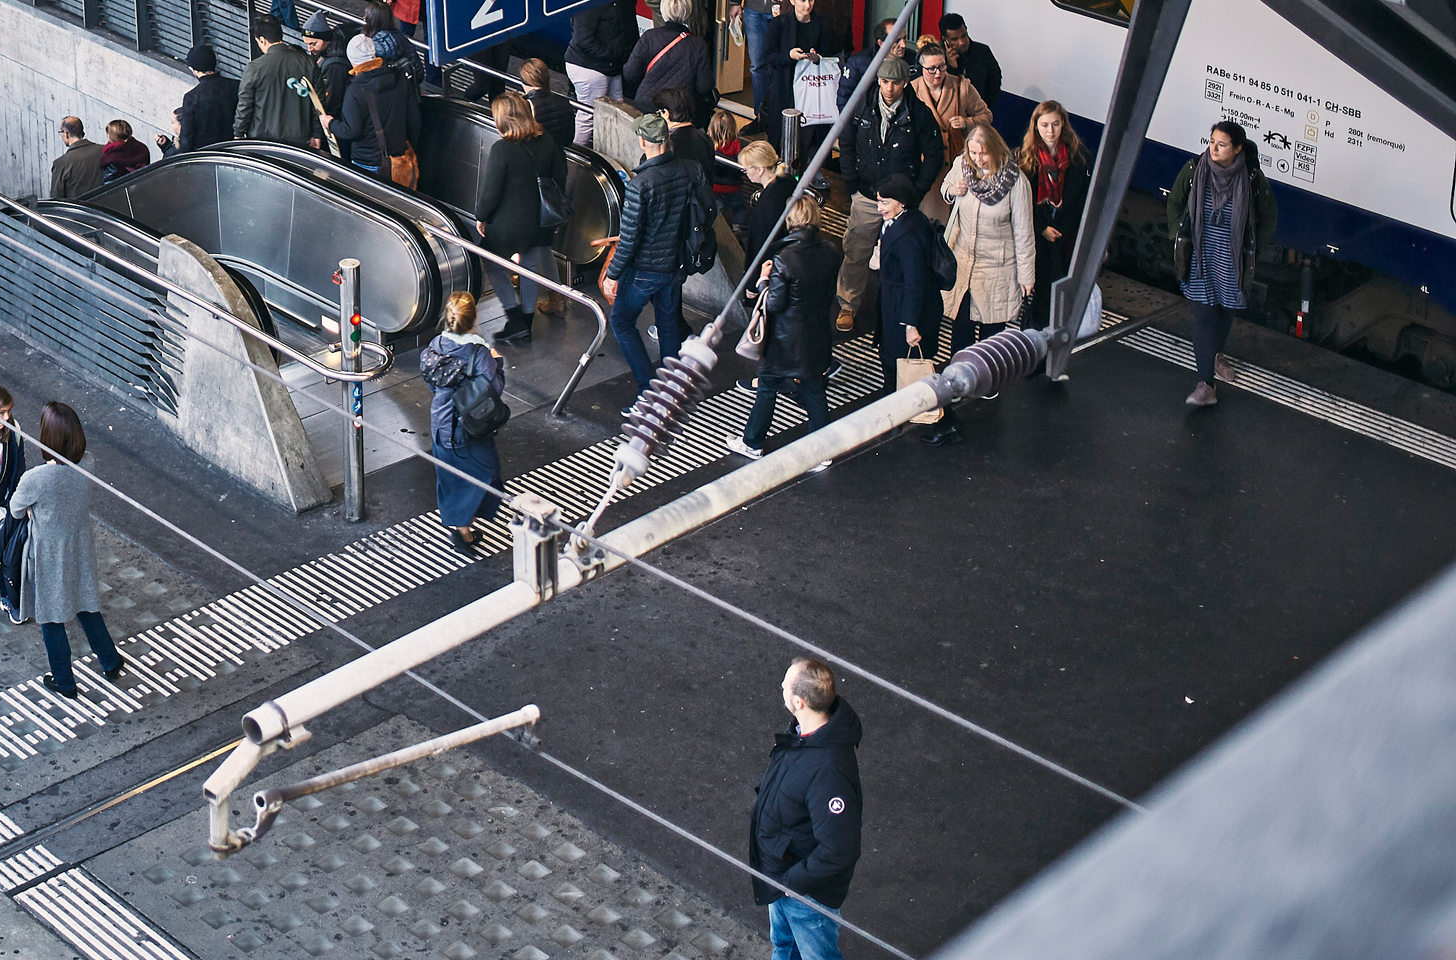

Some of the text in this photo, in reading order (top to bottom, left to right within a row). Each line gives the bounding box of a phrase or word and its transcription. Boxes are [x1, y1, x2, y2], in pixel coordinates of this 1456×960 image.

[1207, 81, 1222, 91] 292t
[1206, 65, 1362, 119] RABe 511 94 85 0 511 041-1 CH-SBB
[1206, 90, 1221, 101] 332t
[1229, 91, 1246, 102] Frein
[1324, 130, 1363, 148] Hd 231t
[1366, 133, 1406, 152] (remorqué)
[1296, 143, 1315, 154] FZPF
[1295, 152, 1315, 164] Video
[1297, 161, 1311, 171] KIS
